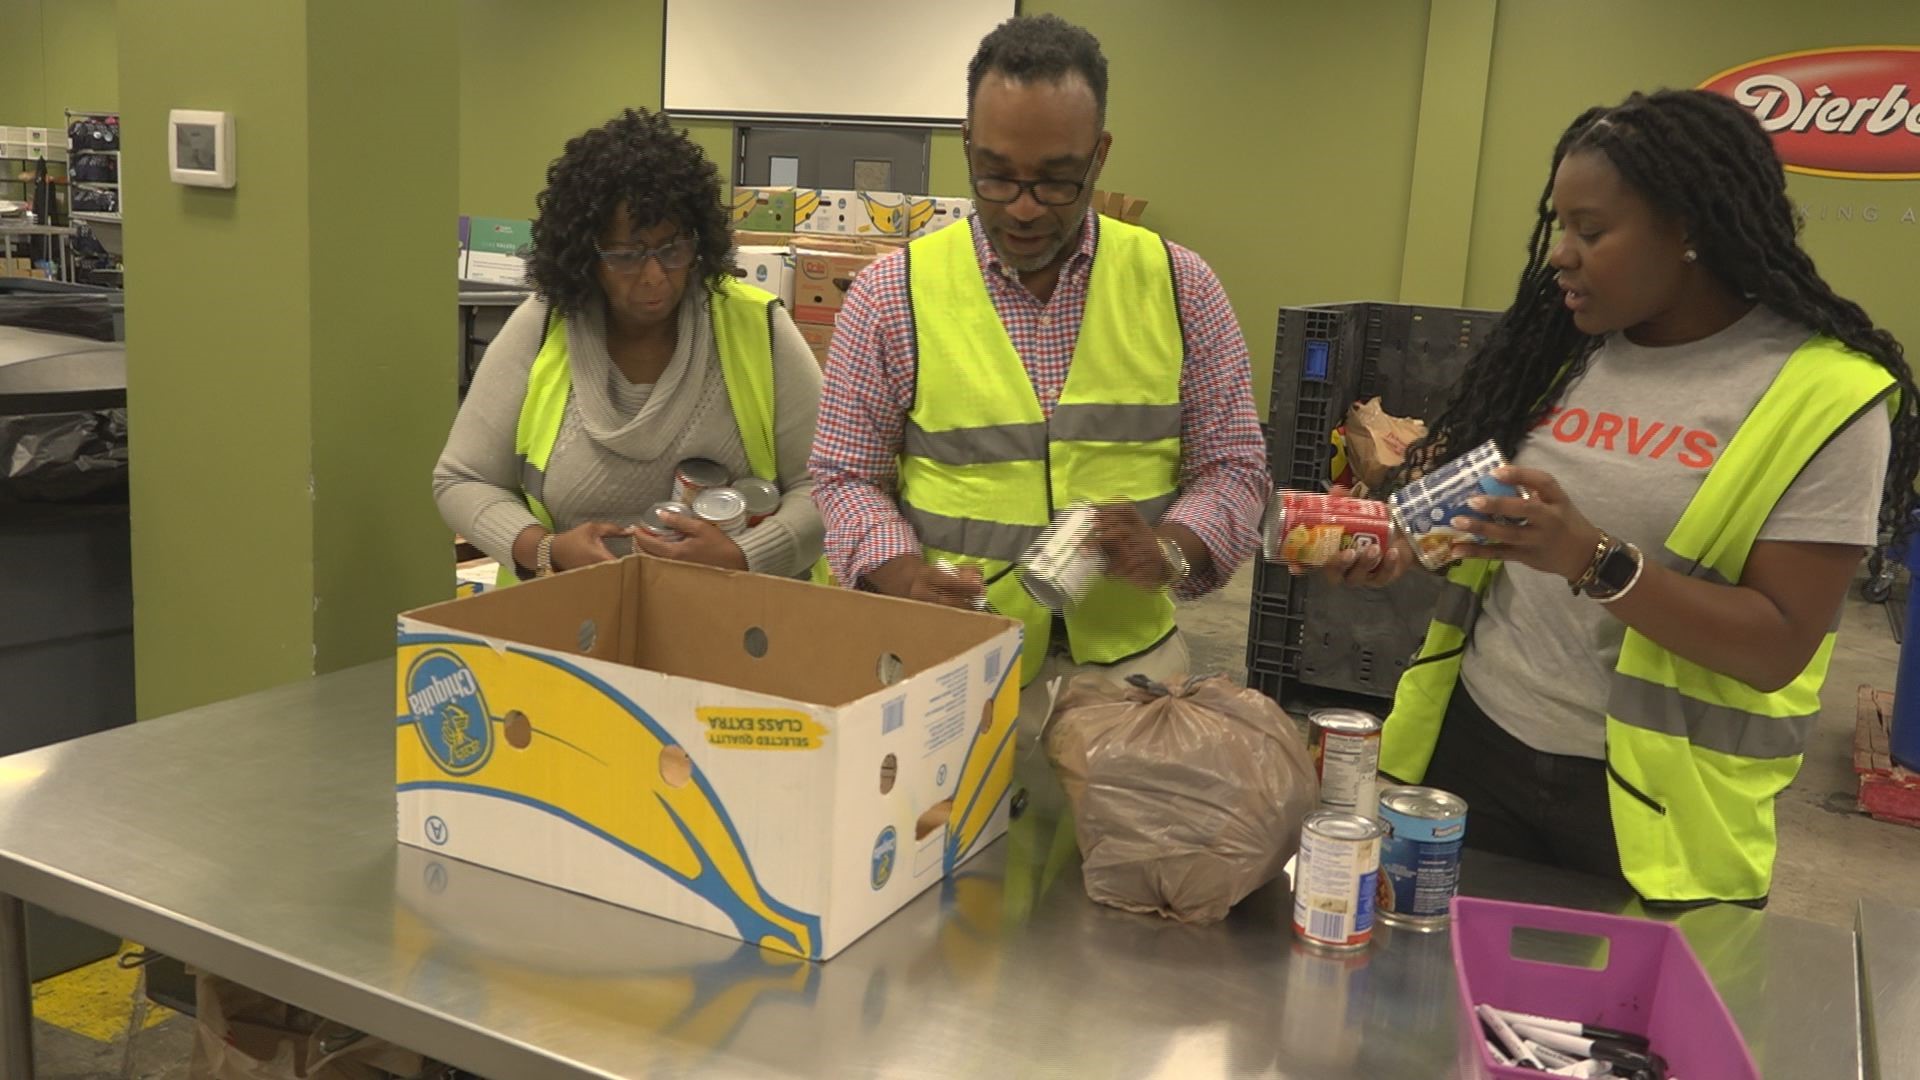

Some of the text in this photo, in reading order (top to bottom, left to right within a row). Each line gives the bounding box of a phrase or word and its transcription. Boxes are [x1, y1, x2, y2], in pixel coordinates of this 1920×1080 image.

[408, 668, 476, 716] Chiquita
[708, 716, 803, 732] CLASS EXTRA
[709, 734, 809, 747] SELECTED QUALITY
